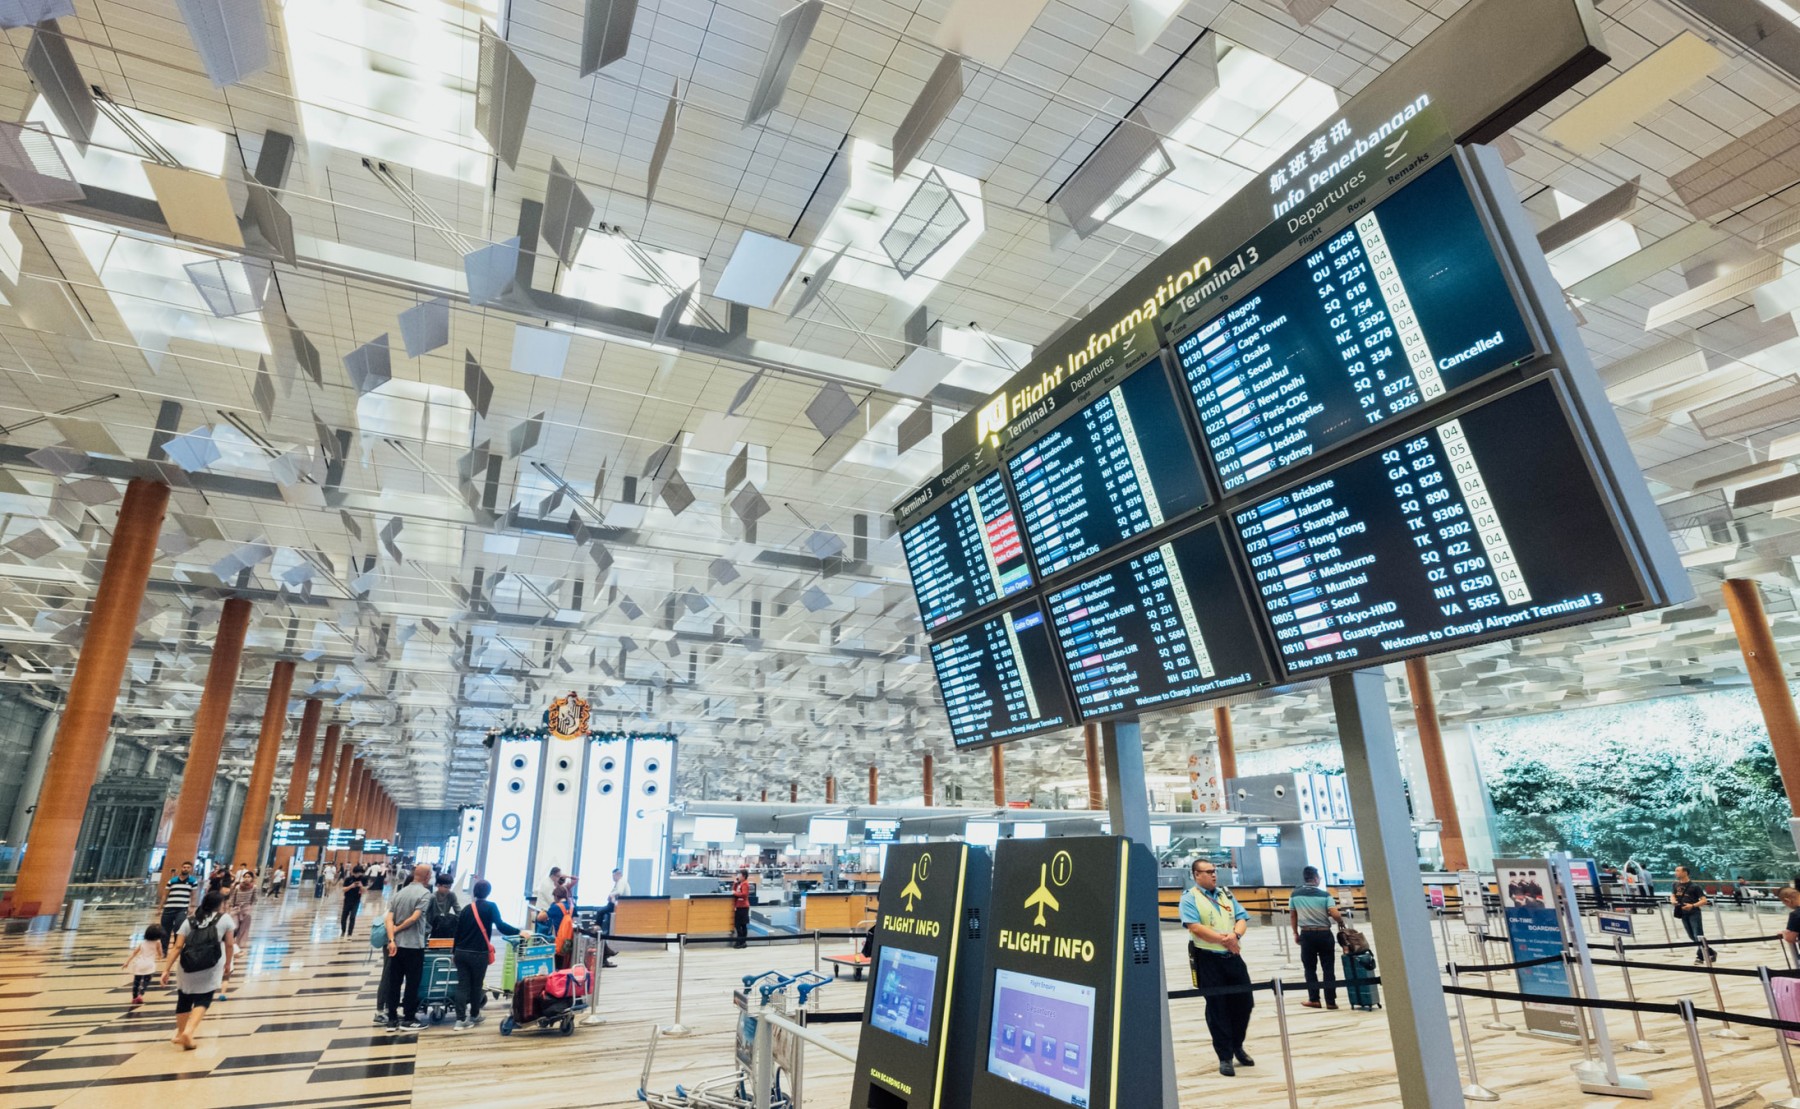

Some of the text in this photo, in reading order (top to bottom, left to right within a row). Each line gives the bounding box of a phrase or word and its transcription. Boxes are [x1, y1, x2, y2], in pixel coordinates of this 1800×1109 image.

[1269, 117, 1352, 194] 航班资讯
[1272, 93, 1431, 220] Info Penerbangan
[1171, 152, 1430, 336] Time To Flight Row Remarks
[1177, 170, 1368, 313] Terminal 3 Departures
[1178, 218, 1374, 355] 0120 Nagoya NH 6268 04
[1183, 234, 1381, 368] 0130 Zurich OU 5815 04
[1187, 250, 1387, 381] 0130 Cape Town SA 7231 04
[1012, 256, 1212, 419] Flight Information
[1192, 266, 1394, 394] 0130 Osaka SQ 618 04
[1196, 282, 1400, 408] 0145 Seoul OZ 754 10
[1201, 299, 1407, 421] 0150 Istanbul NZ 3392 04
[1007, 356, 1115, 439] Terminal 3 Departures
[1205, 315, 1413, 435] 0225 New Delhi NH 6278 04
[1210, 332, 1420, 449] 0230 Paris-CDG SQ 334 04
[1215, 349, 1427, 462] 0230 Los Angeles SQ 8 04
[1219, 459, 1240, 476] 0410
[1273, 428, 1308, 452] Jeddah
[1359, 392, 1375, 409] SV
[1418, 366, 1434, 380] 09
[1438, 331, 1504, 370] Cancelled
[1224, 383, 1441, 490] 0705 Sydney TK 9326 04
[900, 490, 927, 518] Terminal
[941, 462, 971, 487] Departures
[1236, 436, 1429, 525] 0715 Brisbane SQ 265
[1241, 454, 1436, 539] 0725 Jakarta GA 823
[1246, 471, 1443, 553] 0730 Shanghai SQ 828
[1251, 488, 1450, 567] 0735 Hong Kong SQ 890
[1256, 503, 1464, 582] 0740 Perth TK 9306
[1261, 520, 1472, 596] 0745 Melbourne TK 9302
[1266, 540, 1471, 611] 0745 Mumbai SQ 422
[1271, 556, 1486, 625] 0805 Seoul OZ 6790
[1277, 574, 1493, 640] 0805 Tokyo-HND NH 6250
[1282, 592, 1501, 655] 0810 Guangzhou VA 5655
[1287, 647, 1358, 671] 25 Nov 2018 20:19
[1380, 592, 1604, 651] Welcome to Changi Airport Terminal 3
[1135, 694, 1163, 706] Welcome
[1169, 686, 1192, 698] Changi
[1191, 681, 1216, 694] Airport
[1213, 673, 1246, 688] Terminal
[1244, 672, 1252, 682] 3
[465, 840, 474, 852] 7
[501, 813, 521, 842] 9
[883, 915, 940, 938] FLIGHT INFO
[999, 929, 1095, 962] FLIGHT INFO
[870, 1067, 912, 1095] SCAN BOARDING PASS
